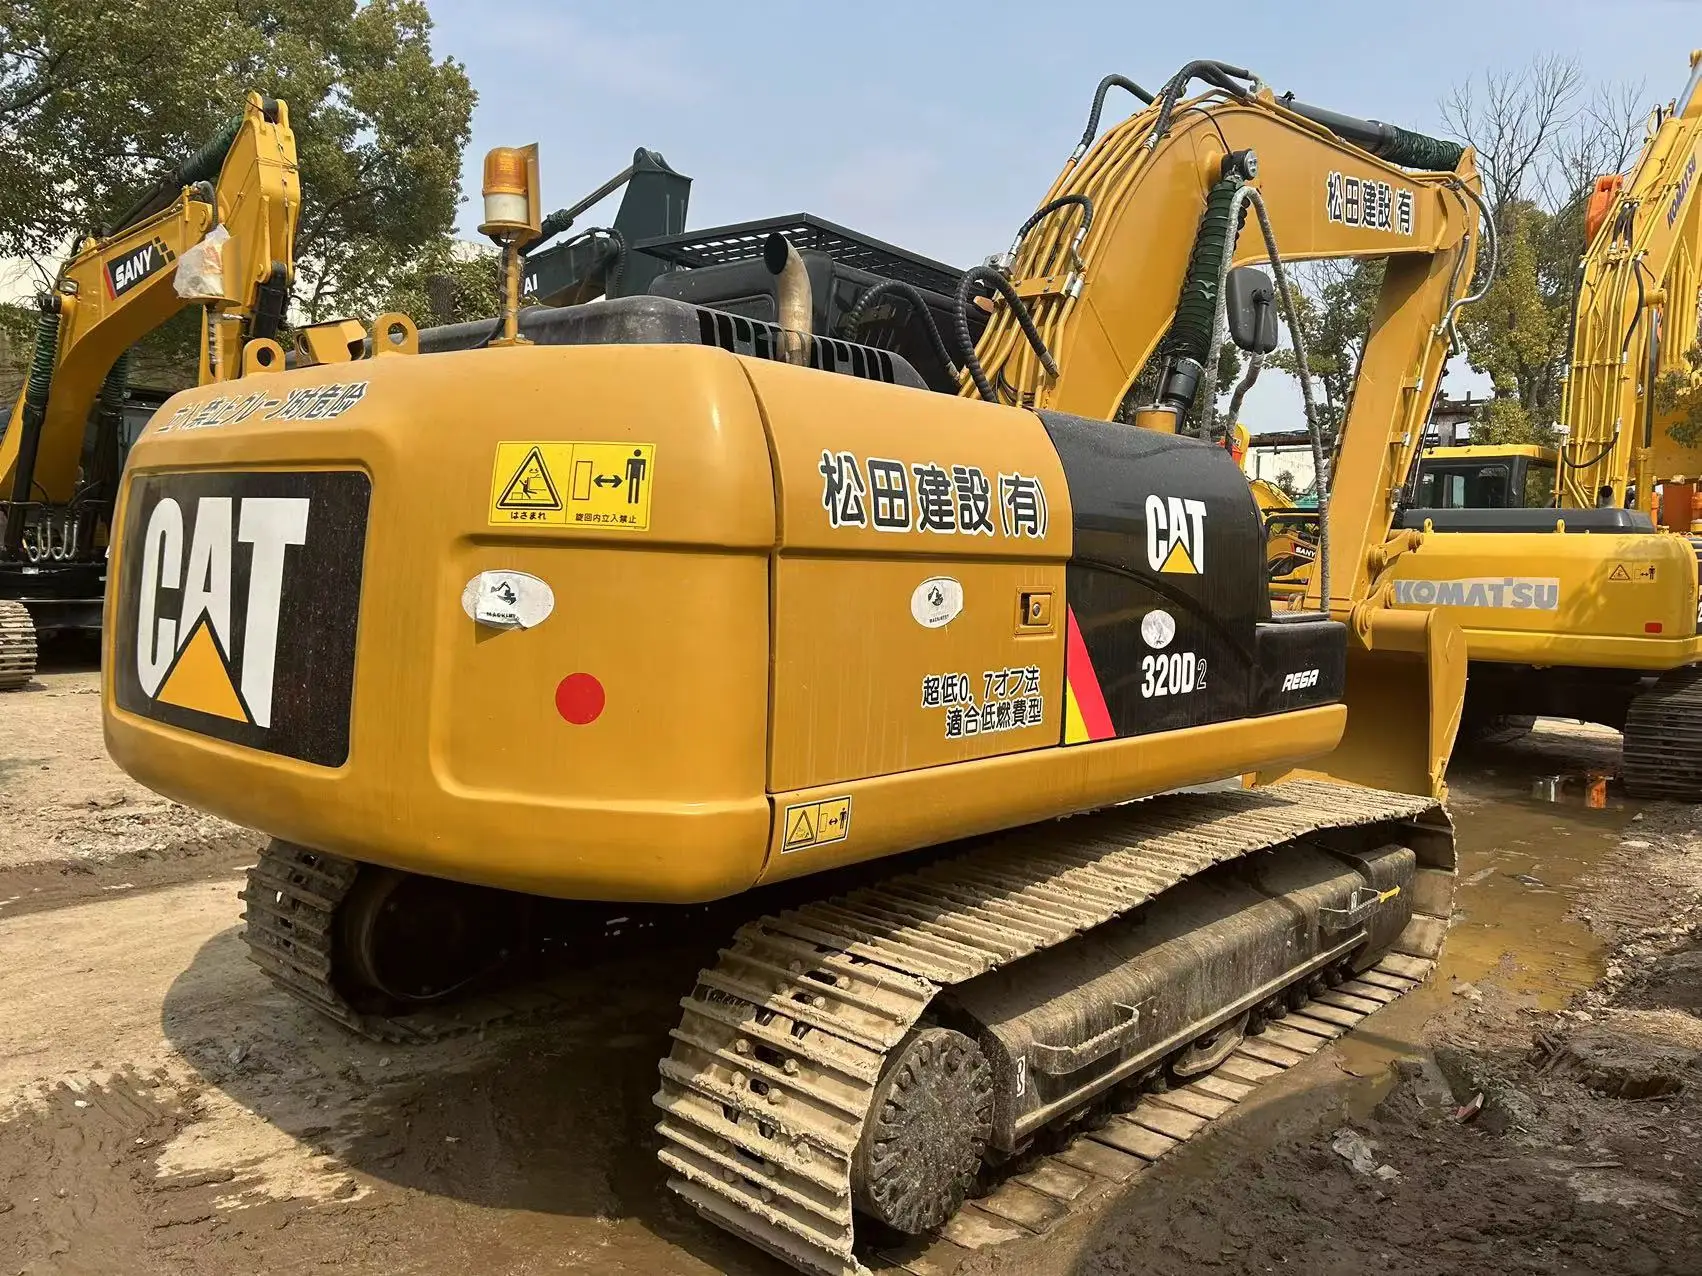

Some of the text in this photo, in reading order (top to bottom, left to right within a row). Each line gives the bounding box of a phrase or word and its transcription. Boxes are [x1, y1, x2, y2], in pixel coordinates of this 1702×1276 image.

[115, 245, 153, 290] SANY
[510, 511, 546, 520] はさまれ
[1145, 495, 1207, 575] CAT
[1295, 546, 1316, 558] SANY
[137, 497, 310, 729] CAT
[1394, 577, 1558, 609] KOMATSU
[945, 696, 1043, 737] 適合低燃費型
